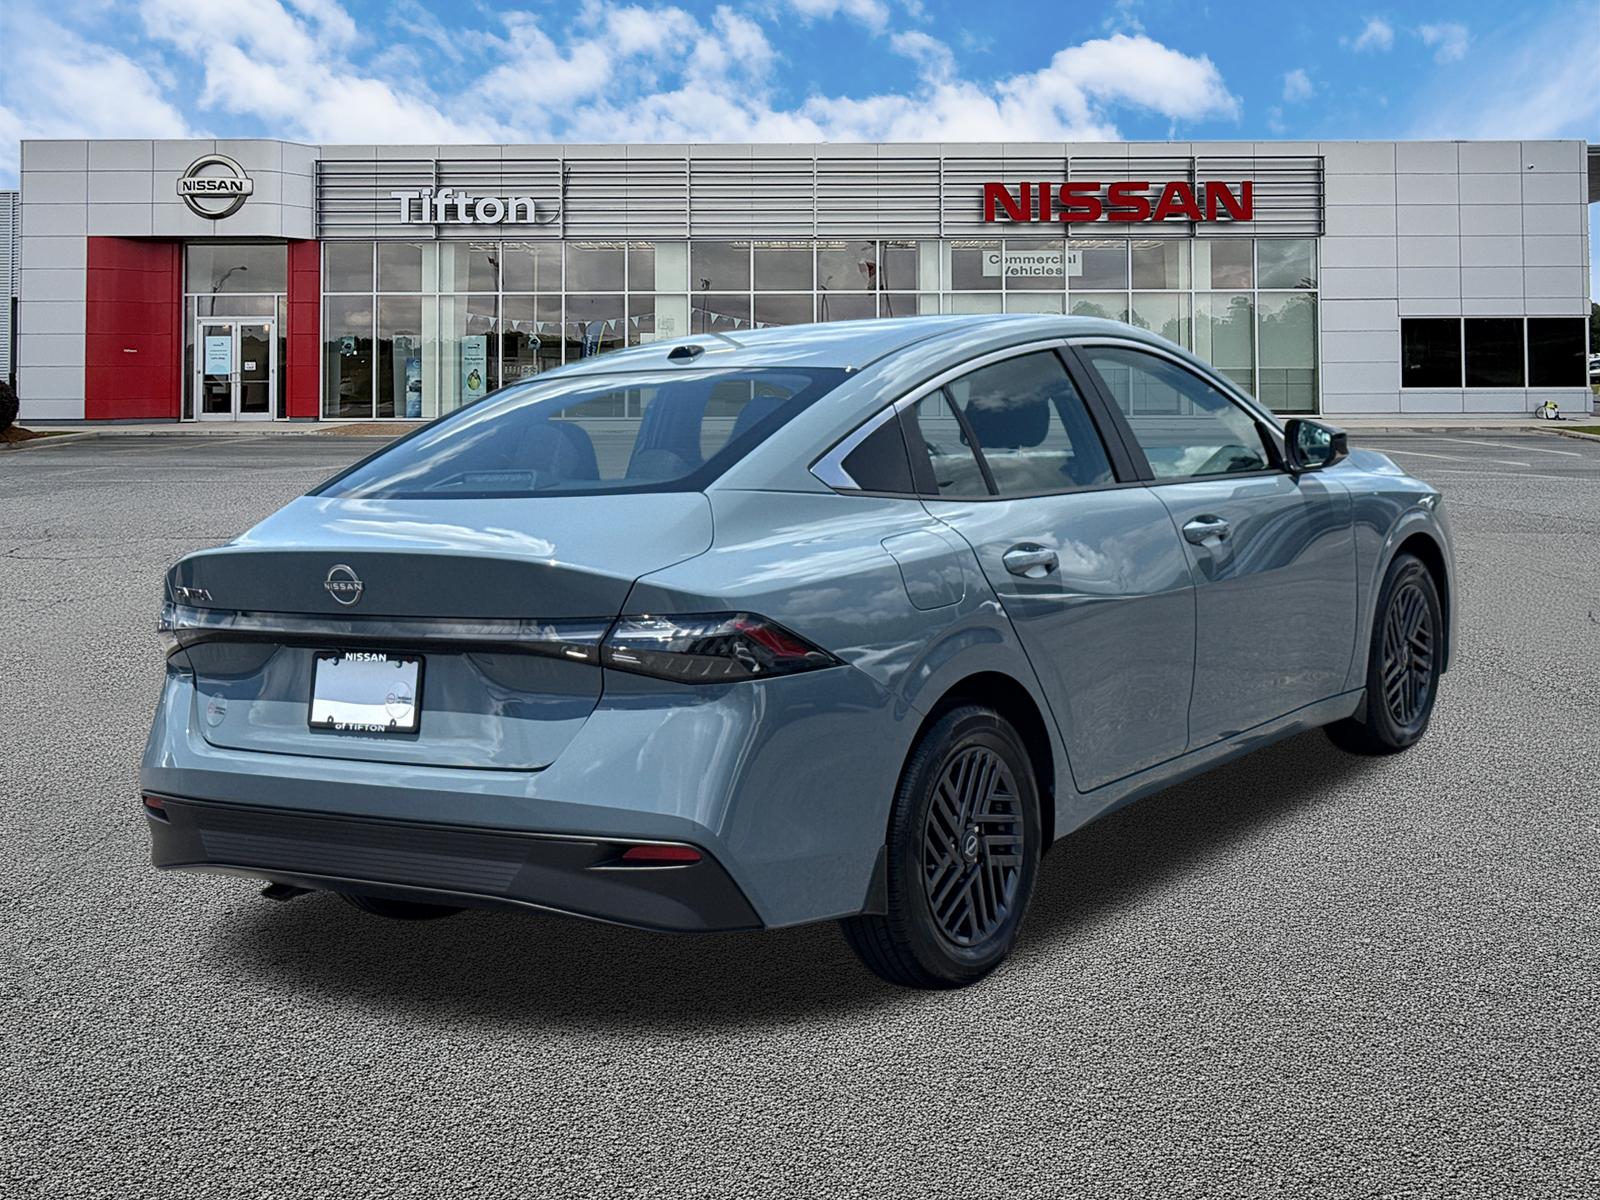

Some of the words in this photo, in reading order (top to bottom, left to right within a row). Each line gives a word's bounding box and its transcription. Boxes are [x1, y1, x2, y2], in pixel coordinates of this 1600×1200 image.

[182, 180, 243, 191] NISSAN
[391, 187, 536, 224] Tifton
[984, 181, 1253, 222] NISSAN
[324, 582, 363, 591] NISSAN
[345, 652, 387, 663] NISSAN
[348, 723, 386, 733] TIFTON
